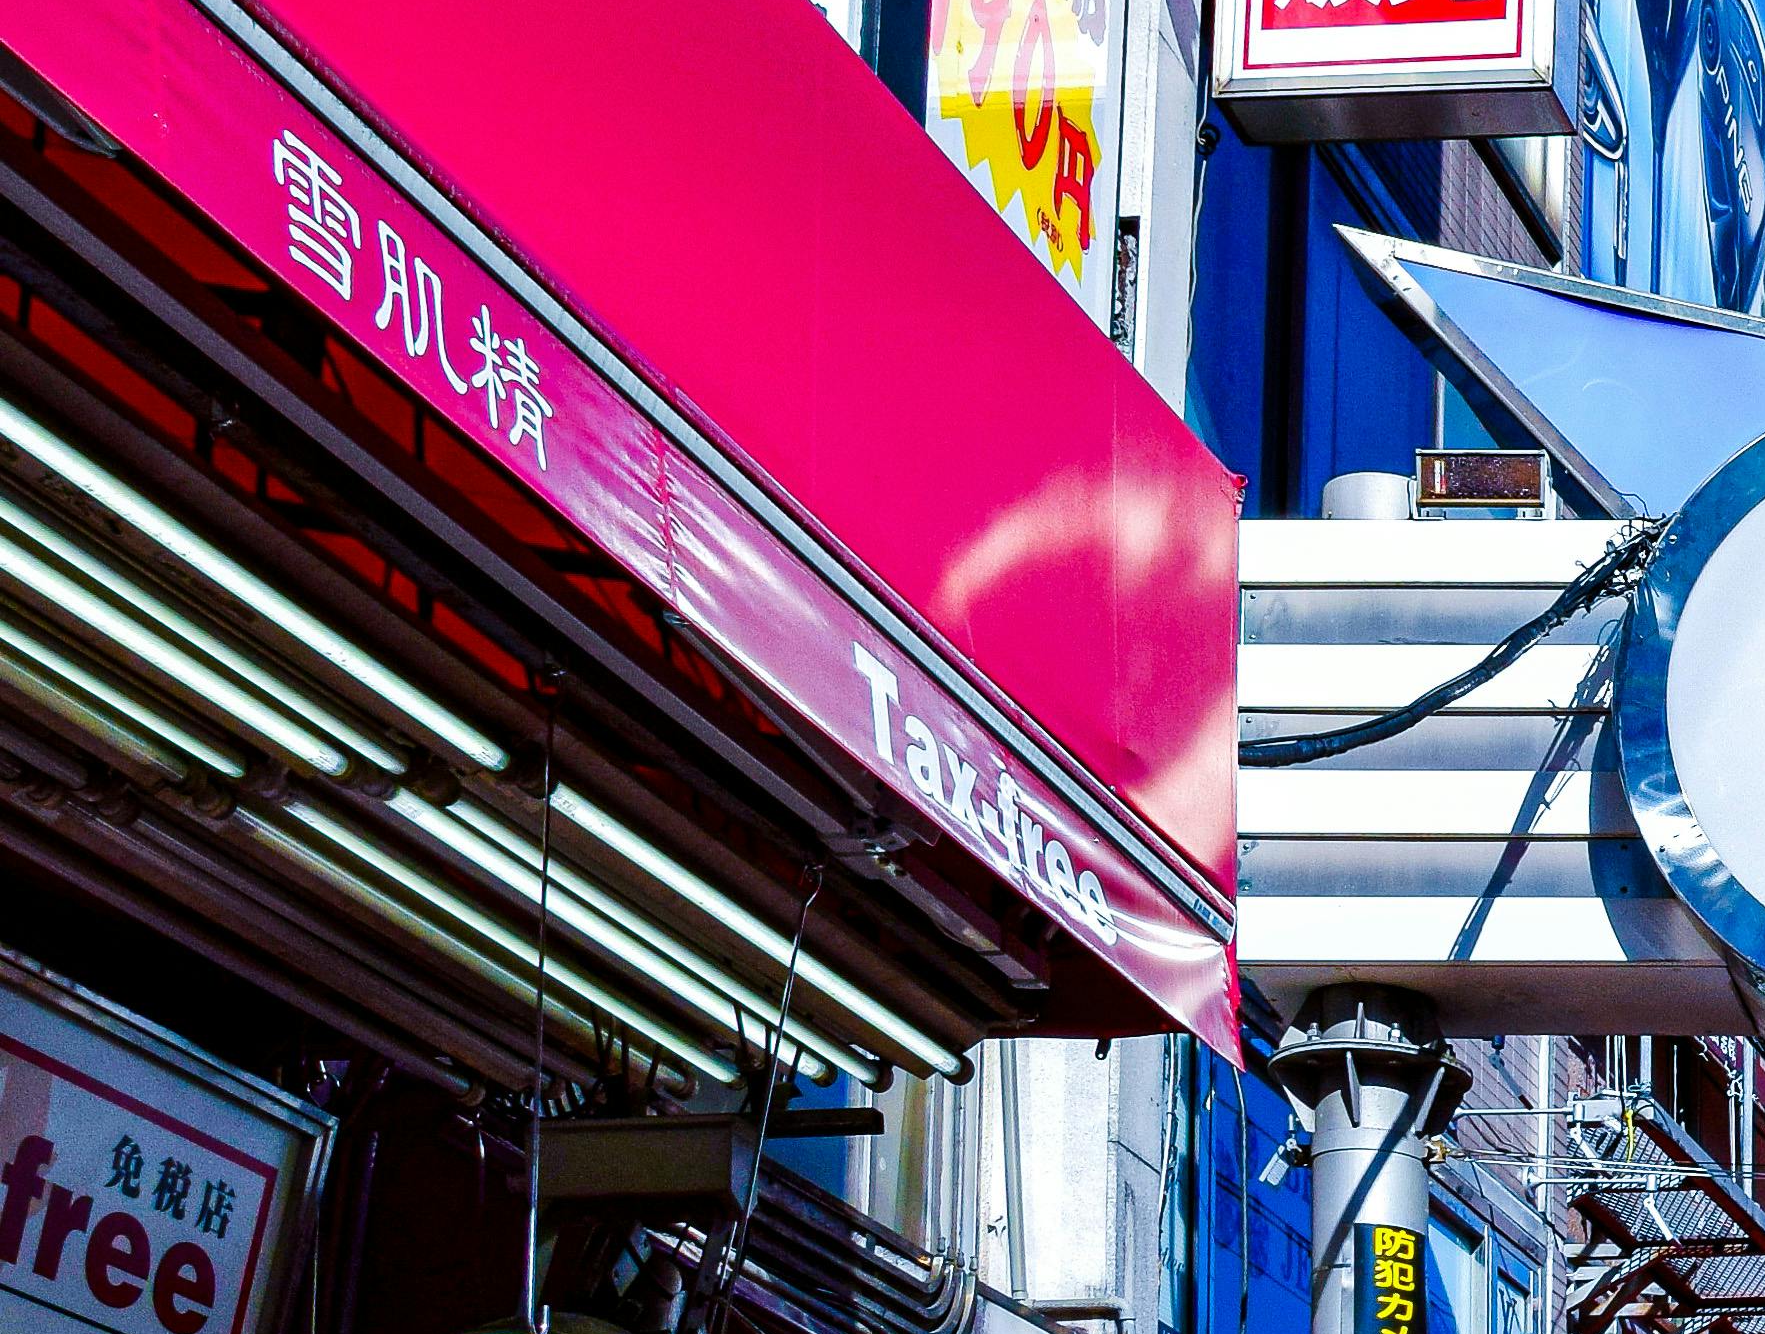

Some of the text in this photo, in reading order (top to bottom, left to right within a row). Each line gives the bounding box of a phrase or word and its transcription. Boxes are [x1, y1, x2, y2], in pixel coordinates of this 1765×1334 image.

[1715, 65, 1753, 214] PING
[273, 130, 554, 471] 雪肌精
[854, 642, 1119, 947] Tax-free
[112, 1133, 238, 1241] 免税店
